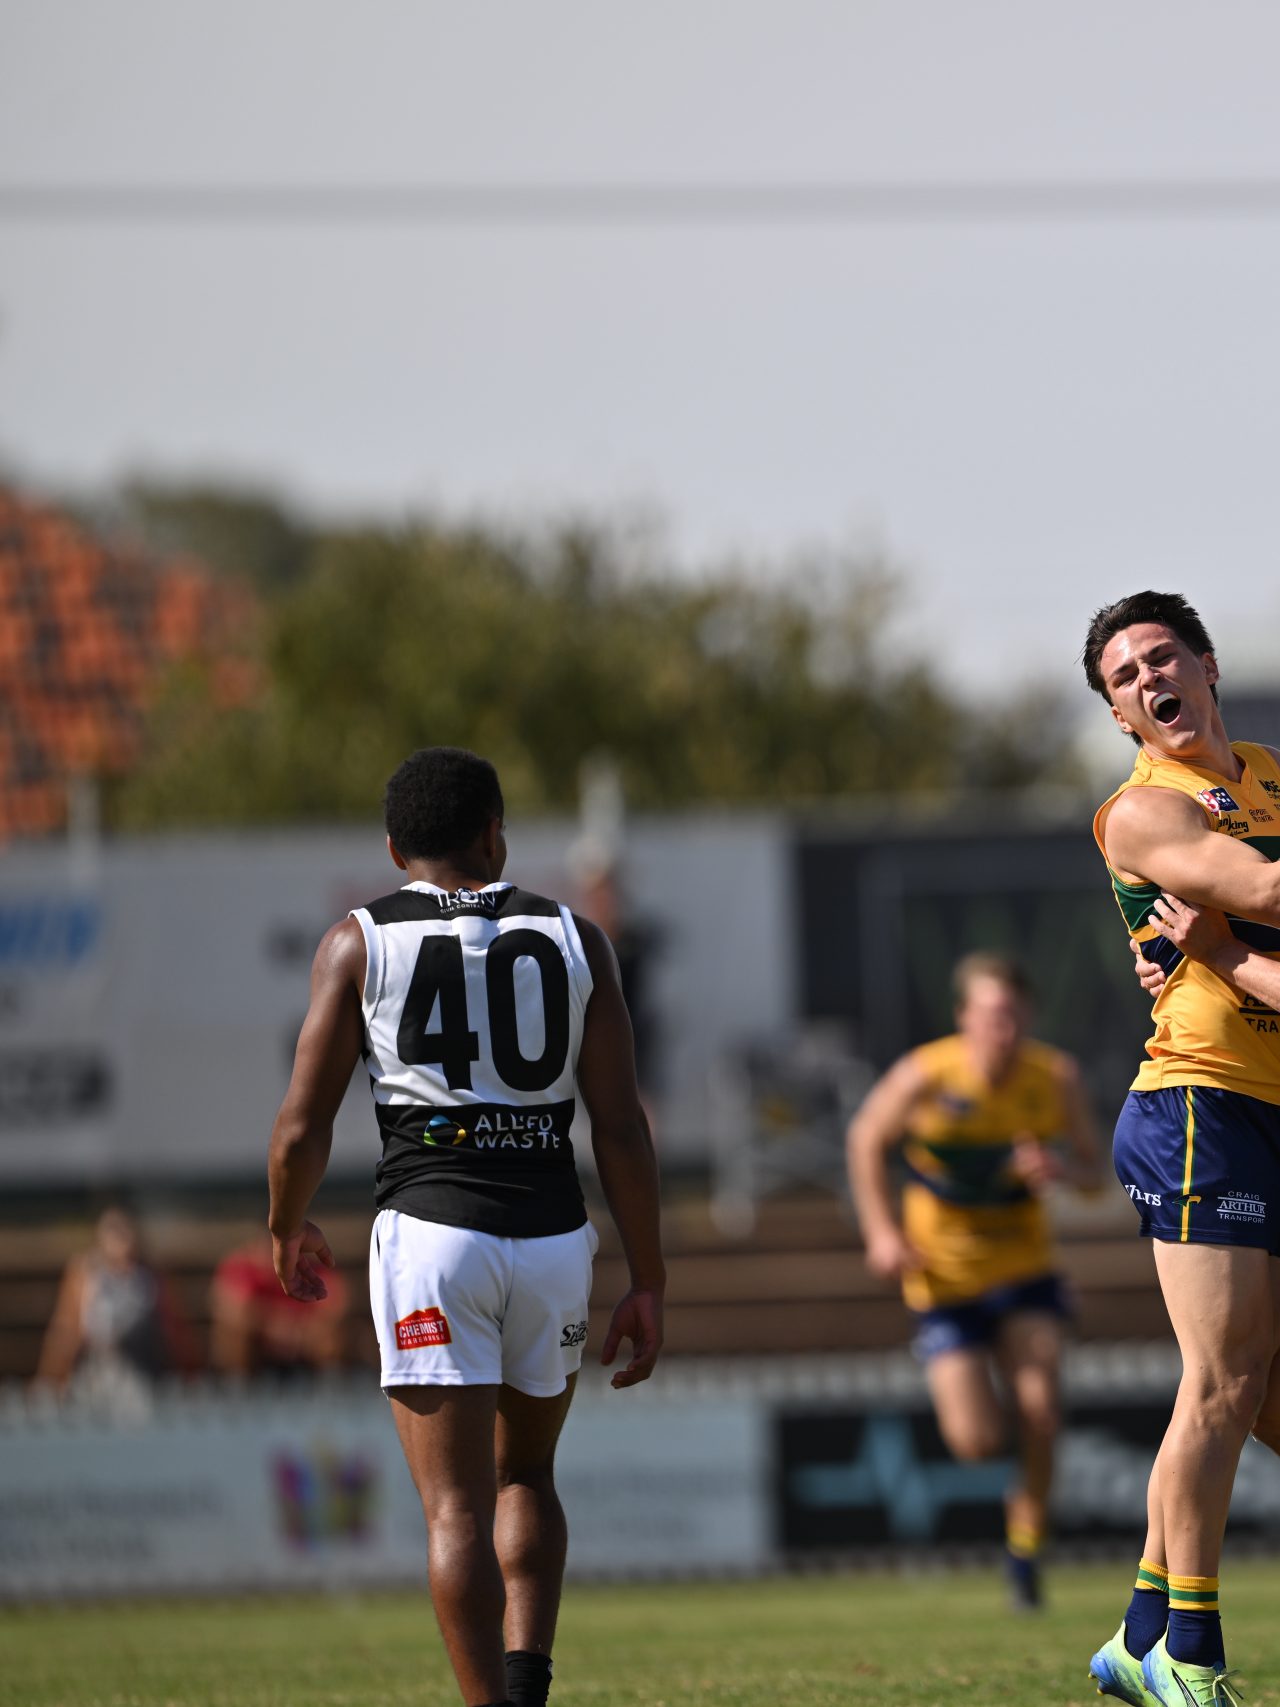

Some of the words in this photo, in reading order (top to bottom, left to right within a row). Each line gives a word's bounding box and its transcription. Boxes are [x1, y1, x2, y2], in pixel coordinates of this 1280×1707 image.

[397, 928, 570, 1092] 40
[1227, 1190, 1260, 1201] CRAIG
[1218, 1200, 1266, 1214] ARTHUR
[1219, 1213, 1265, 1224] TRANSPORT
[399, 1320, 444, 1338] CHEMIST
